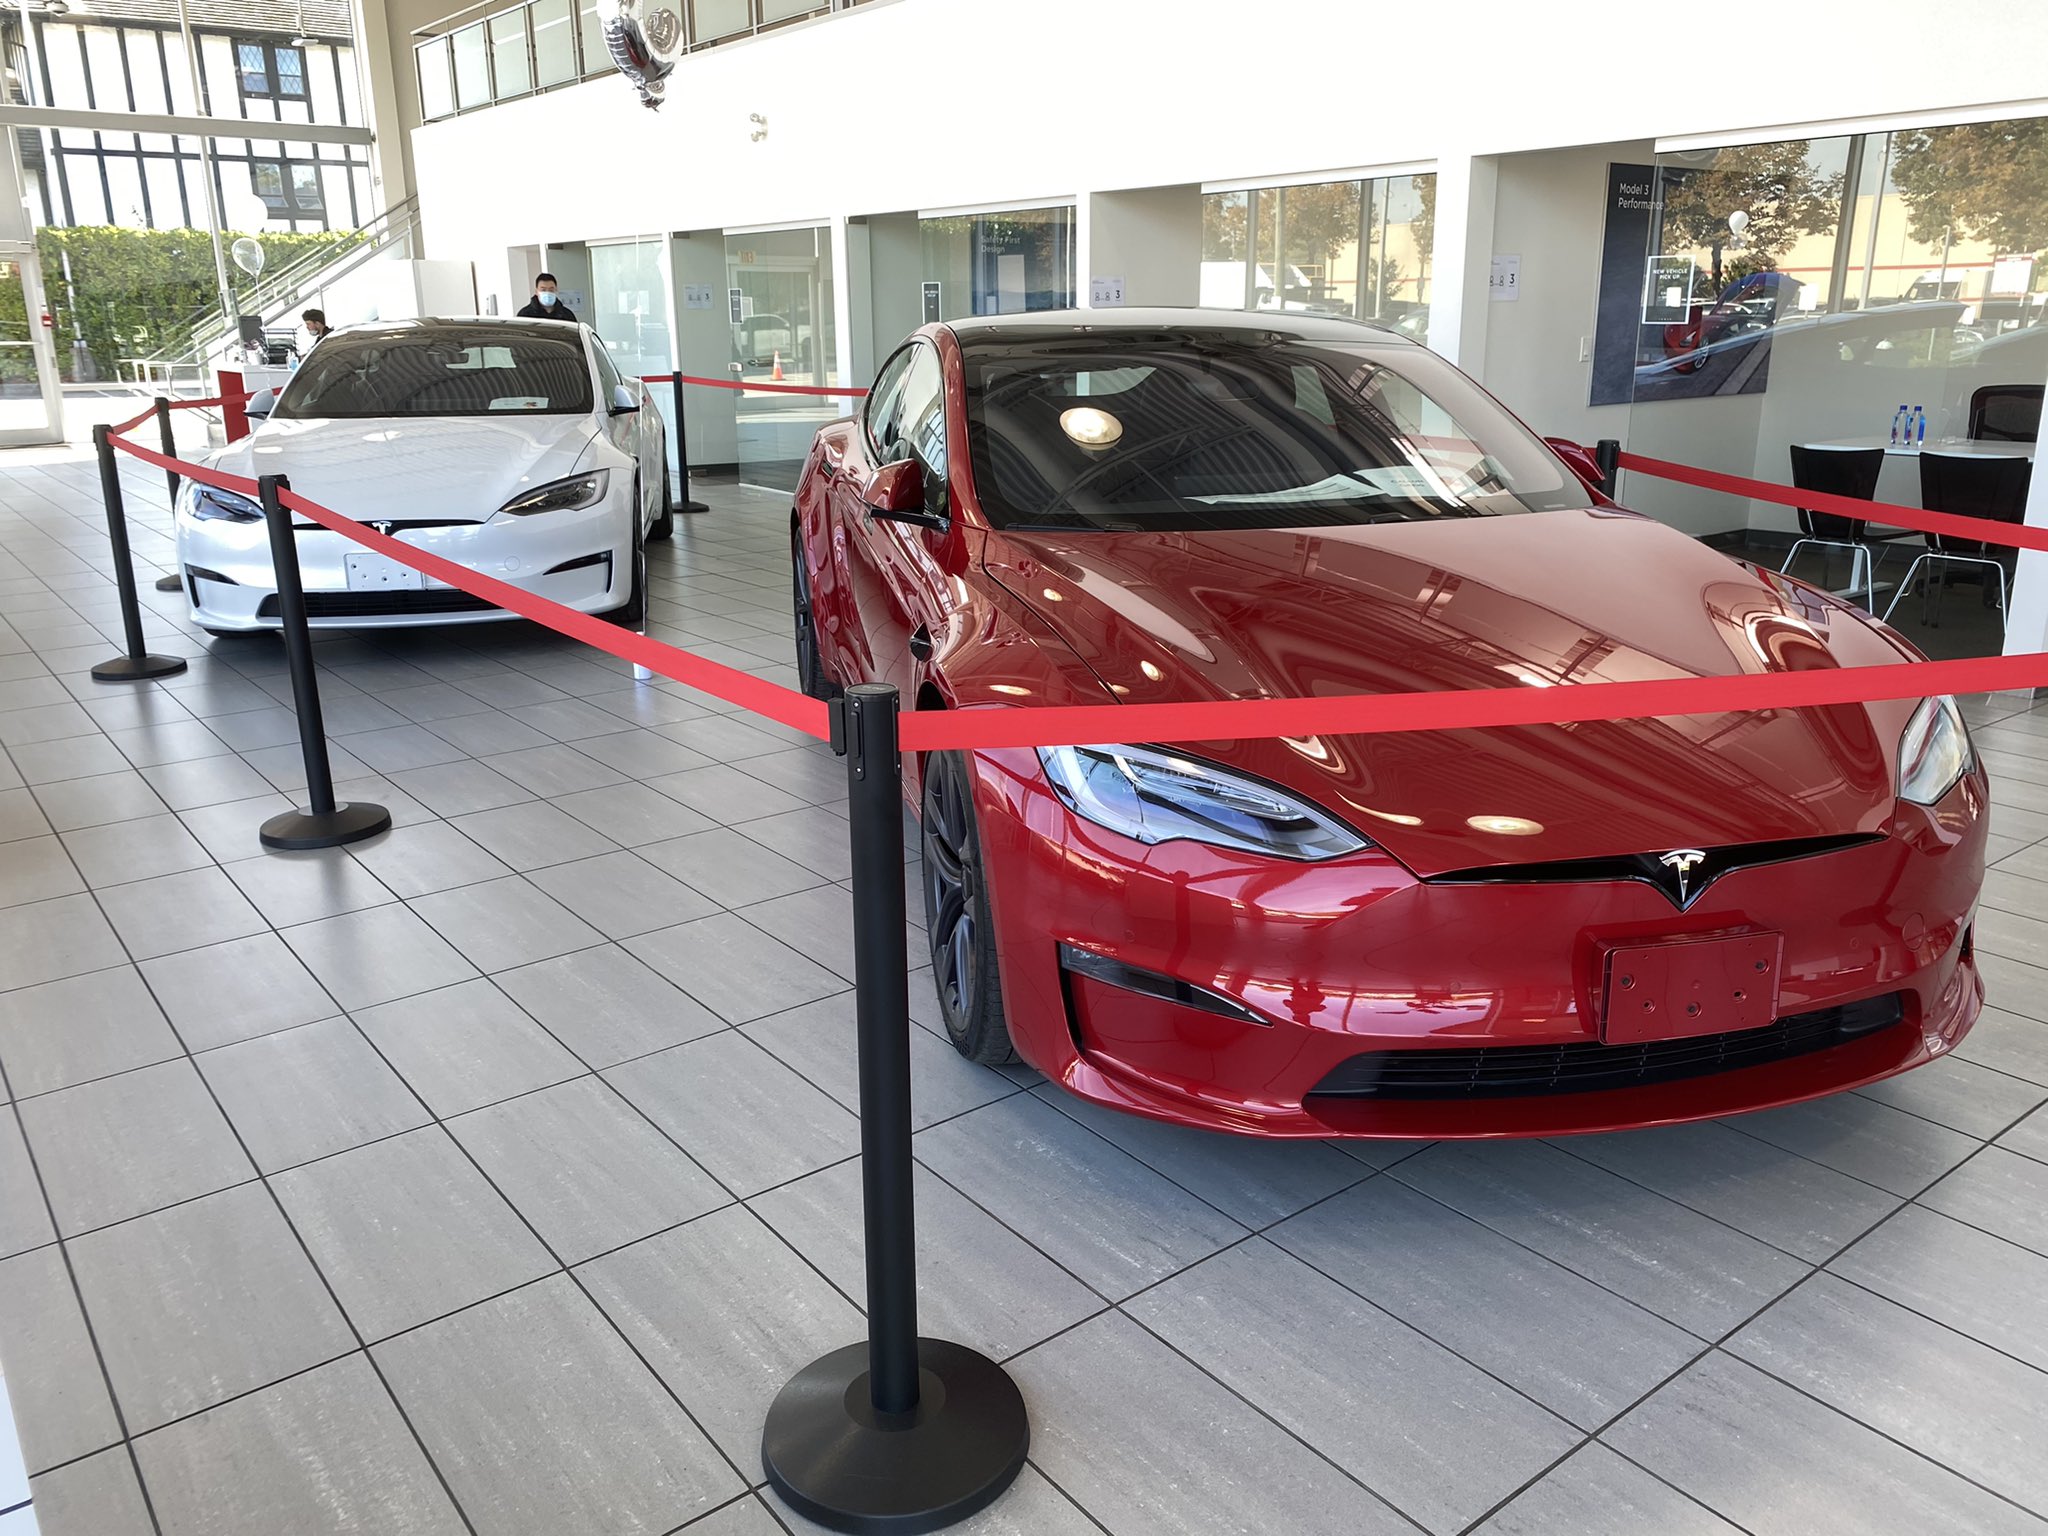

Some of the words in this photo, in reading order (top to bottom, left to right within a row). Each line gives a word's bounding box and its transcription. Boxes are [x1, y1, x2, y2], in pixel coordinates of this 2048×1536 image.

[1620, 183, 1643, 194] Model
[1644, 184, 1649, 195] 3
[1618, 197, 1664, 210] Performance
[1004, 236, 1020, 244] First
[981, 245, 1005, 255] Design
[1509, 273, 1515, 284] 3
[1115, 289, 1121, 299] 3
